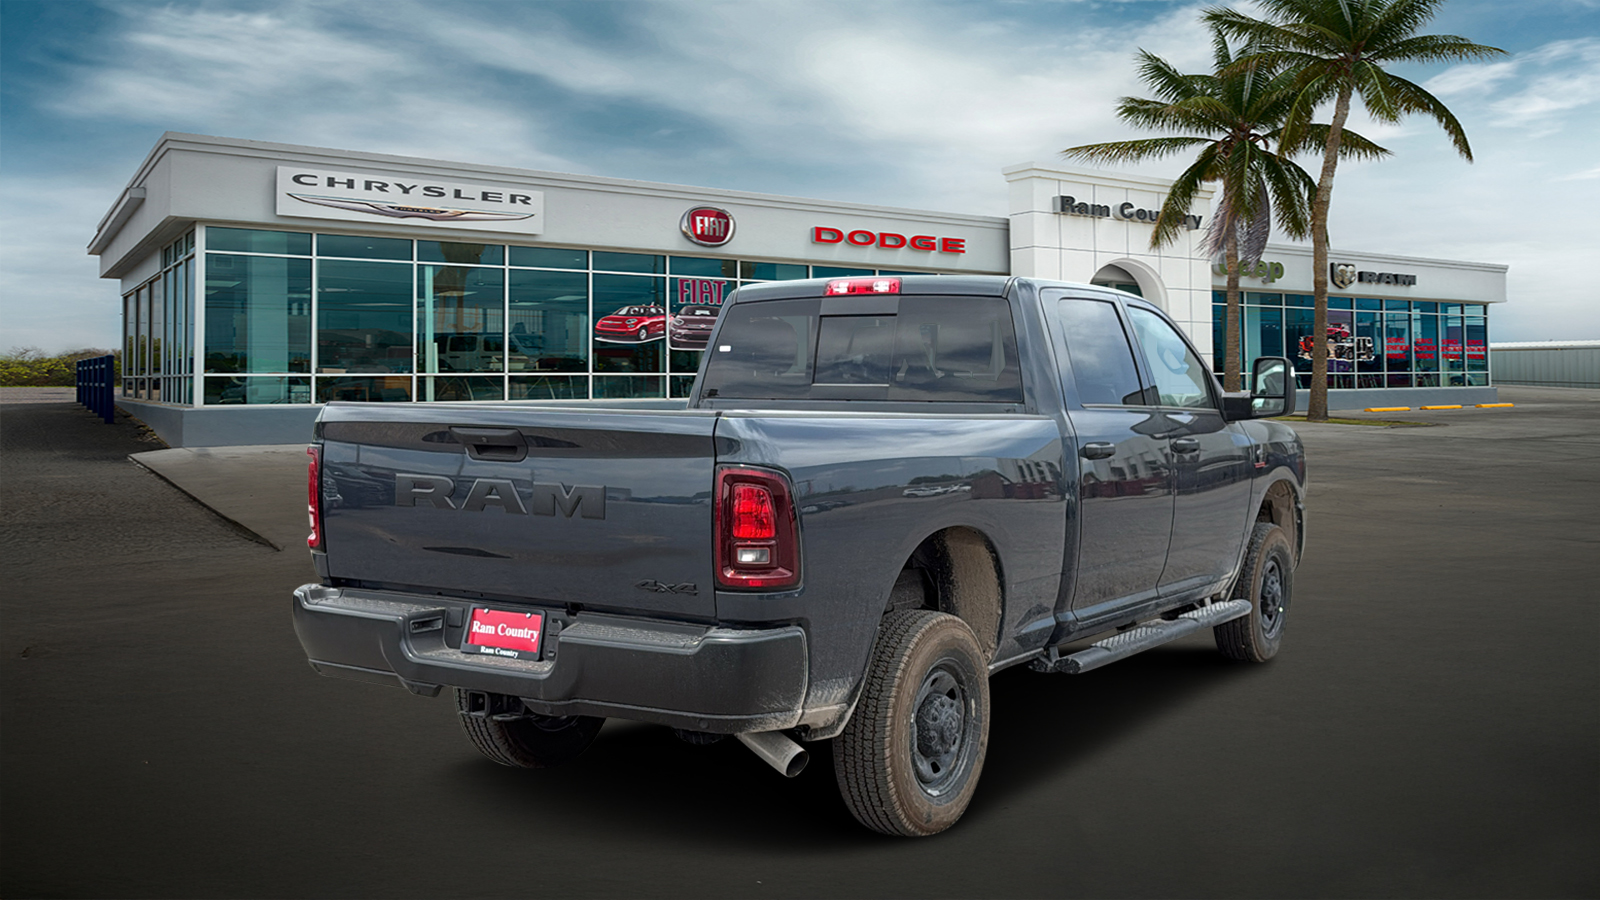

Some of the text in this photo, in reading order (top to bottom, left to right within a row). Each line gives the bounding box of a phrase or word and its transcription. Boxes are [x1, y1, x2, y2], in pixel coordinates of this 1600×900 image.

[292, 173, 533, 206] CHRYSLER
[1058, 195, 1203, 229] Ram Coury
[695, 215, 728, 238] FIAT
[812, 226, 967, 254] DODGE
[1359, 271, 1417, 286] RAM
[678, 278, 727, 305] FIAT
[394, 472, 607, 521] RAM
[635, 578, 699, 596] 4x4
[472, 620, 539, 642] Ram Country
[480, 645, 519, 659] Ram Country
